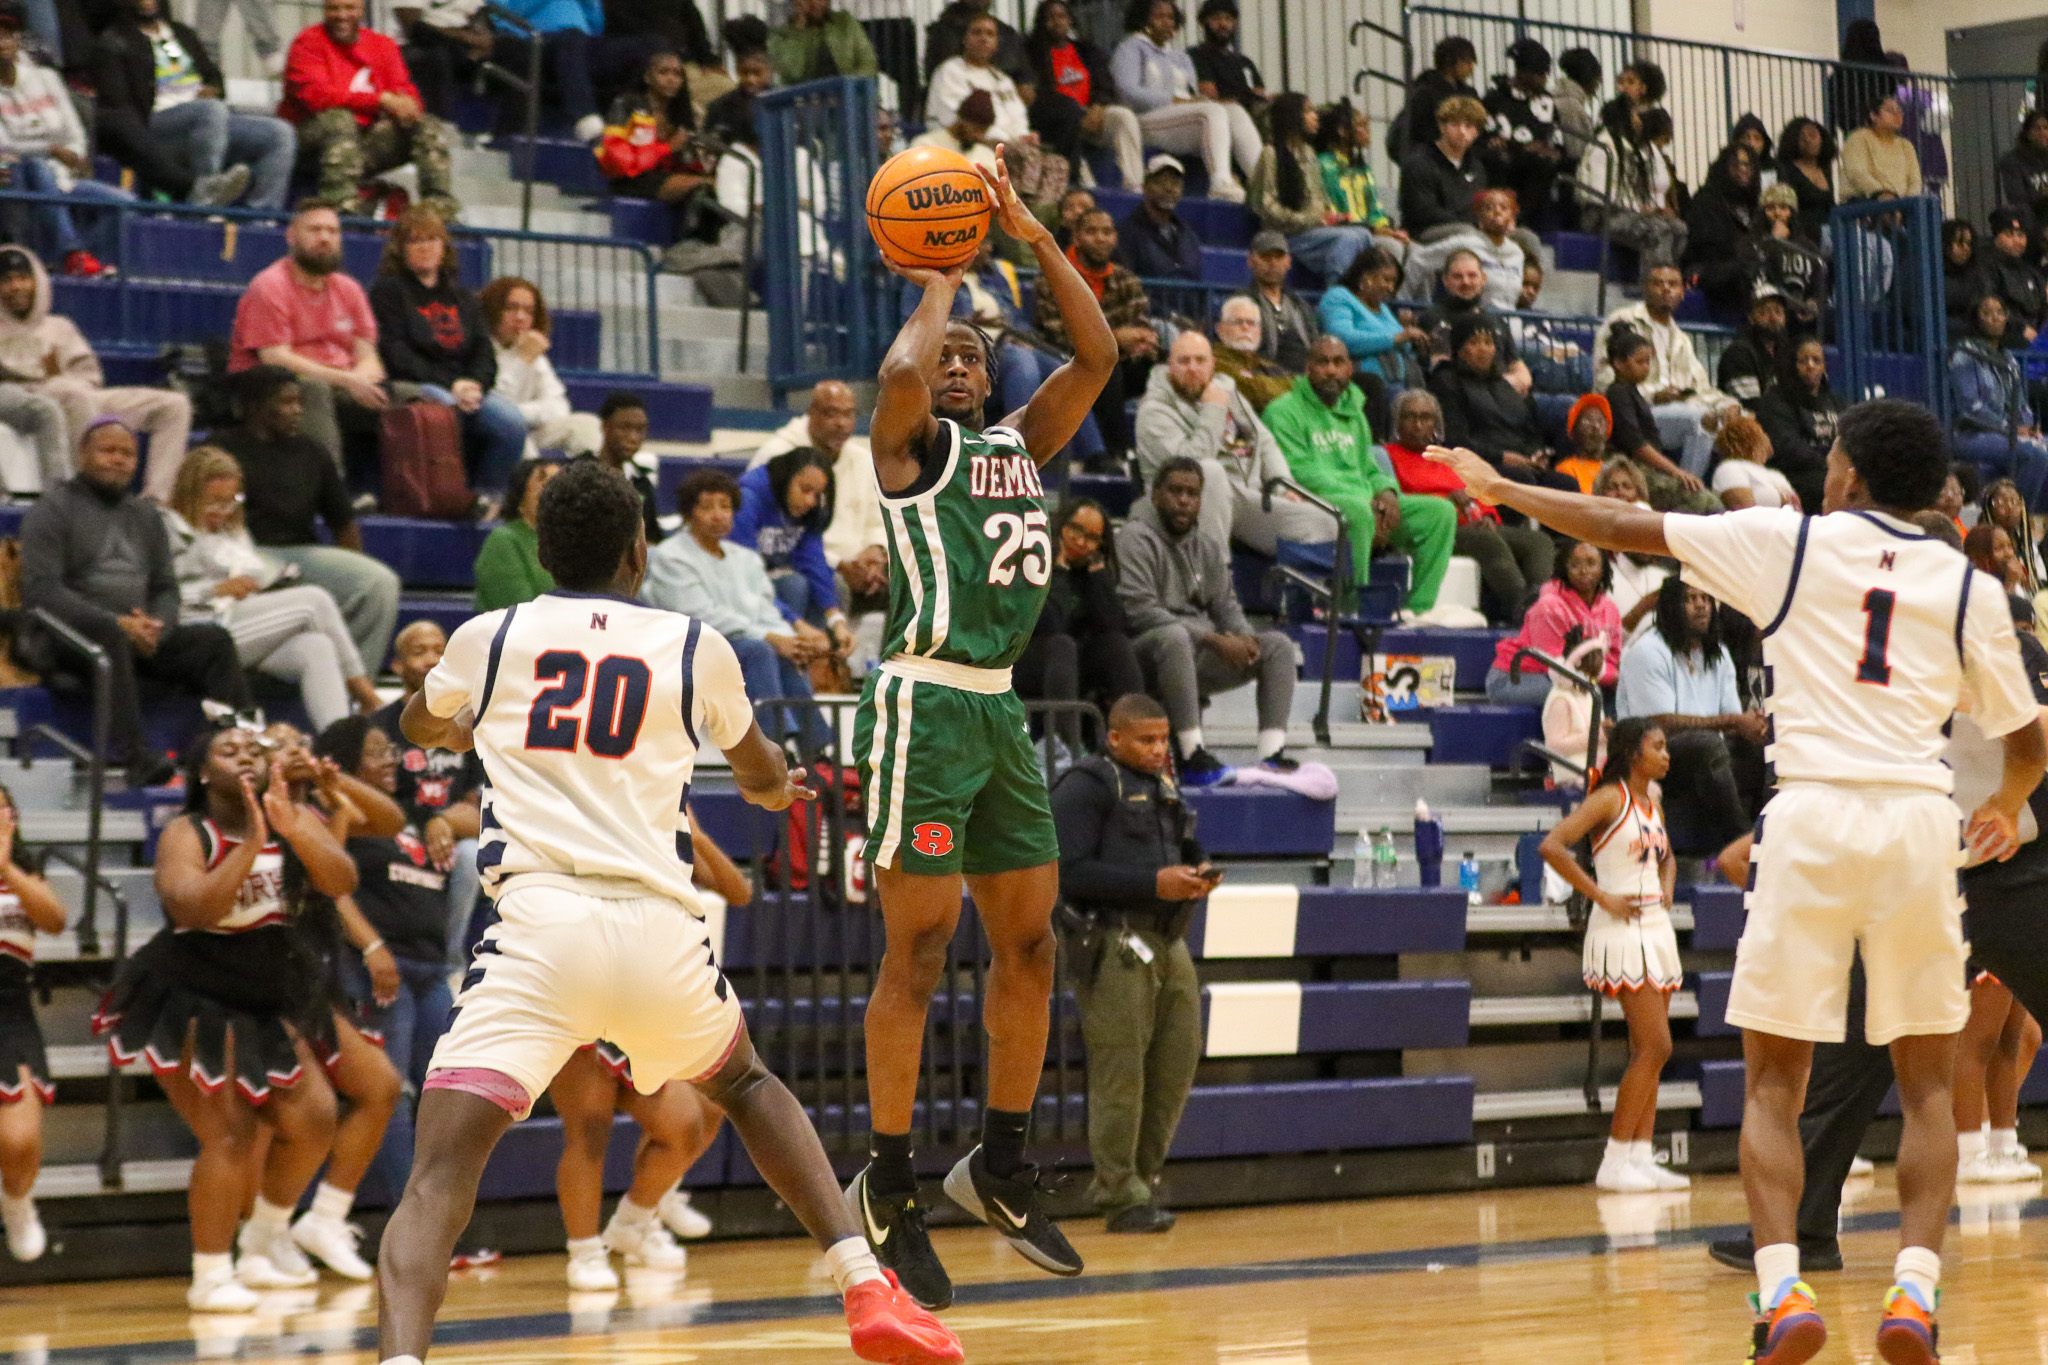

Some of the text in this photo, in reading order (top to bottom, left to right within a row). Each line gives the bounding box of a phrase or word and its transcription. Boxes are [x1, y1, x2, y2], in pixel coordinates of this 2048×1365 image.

[905, 184, 984, 210] Wilson
[923, 225, 978, 246] NCAA
[983, 509, 1052, 587] 25
[1879, 550, 1896, 571] N
[590, 612, 608, 630] N
[1855, 587, 1896, 688] 1
[524, 649, 653, 760] 20
